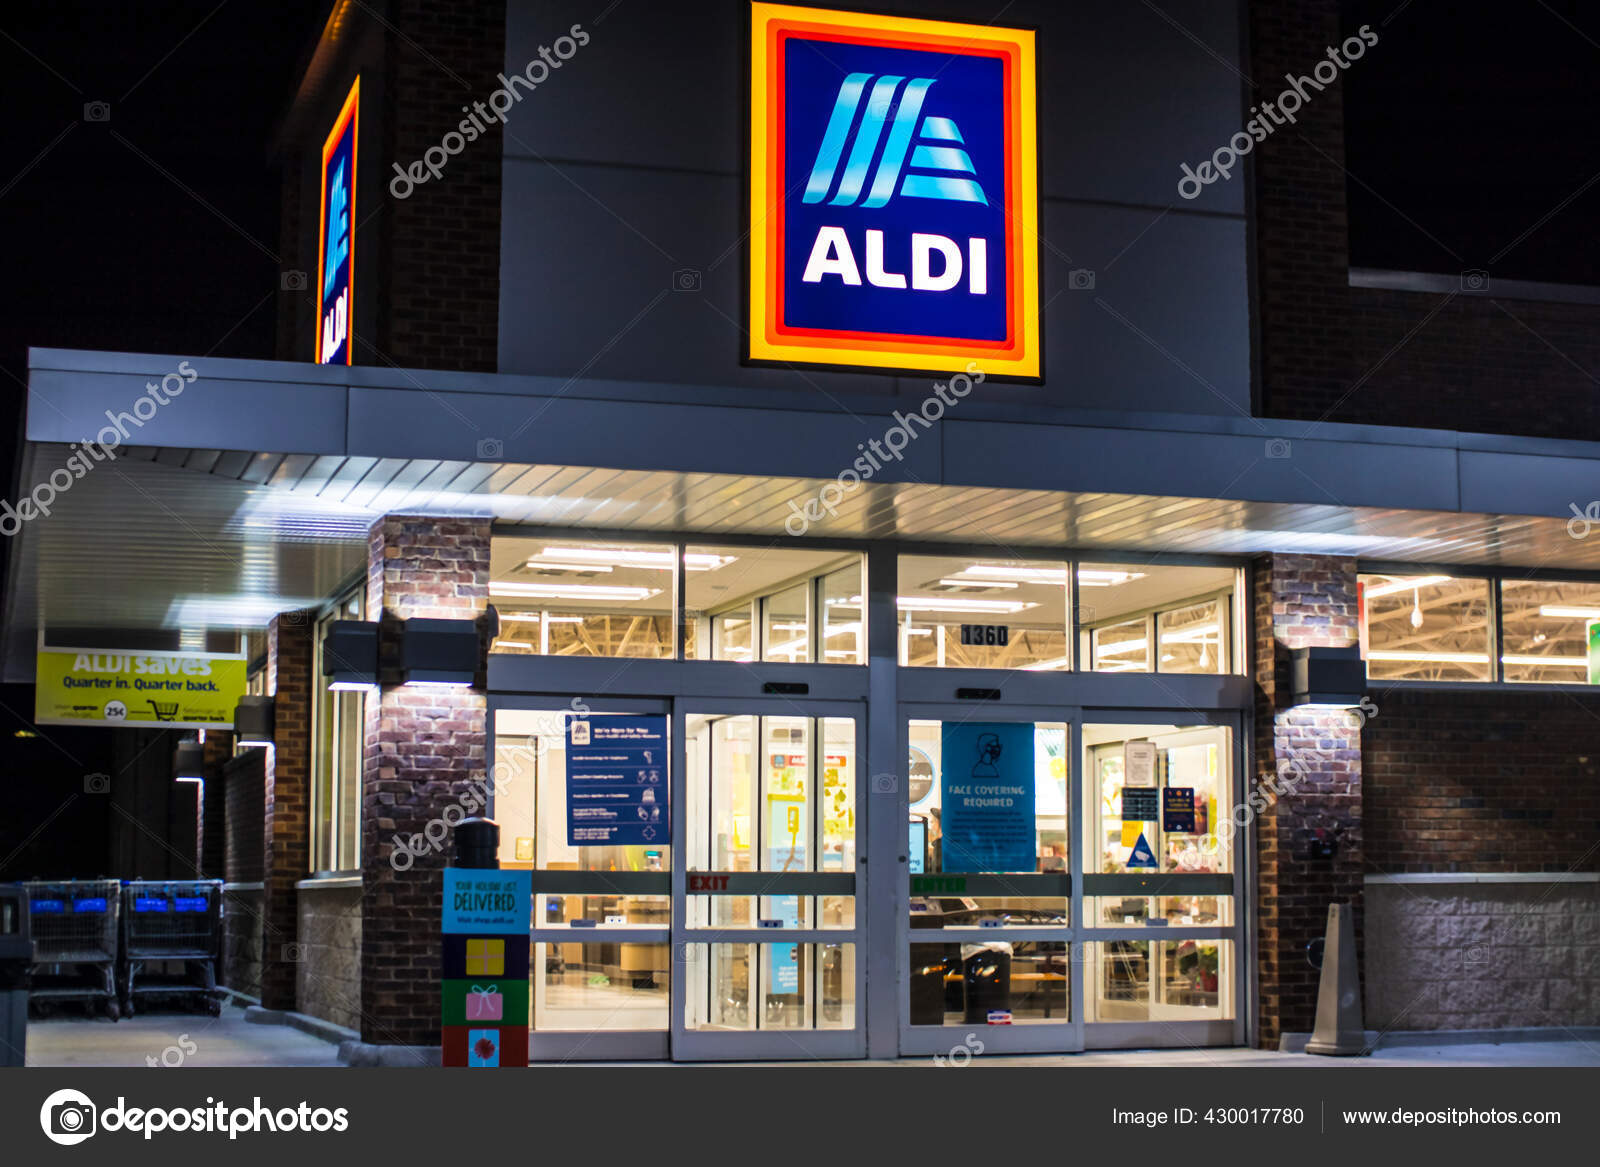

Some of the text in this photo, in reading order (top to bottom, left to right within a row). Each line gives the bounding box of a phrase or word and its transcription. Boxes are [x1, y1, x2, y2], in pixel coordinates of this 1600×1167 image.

[802, 226, 987, 294] ALDI
[321, 286, 348, 364] ALDI
[962, 625, 1008, 646] 1360
[72, 654, 212, 676] ALDI saves
[63, 676, 220, 692] Quarter in. Quarter back.
[948, 785, 1025, 796] FACE COVERING
[963, 797, 1014, 808] REQUIRED
[690, 875, 730, 891] EXIT
[914, 877, 967, 893] ENTER
[454, 892, 518, 913] DELIVERED.
